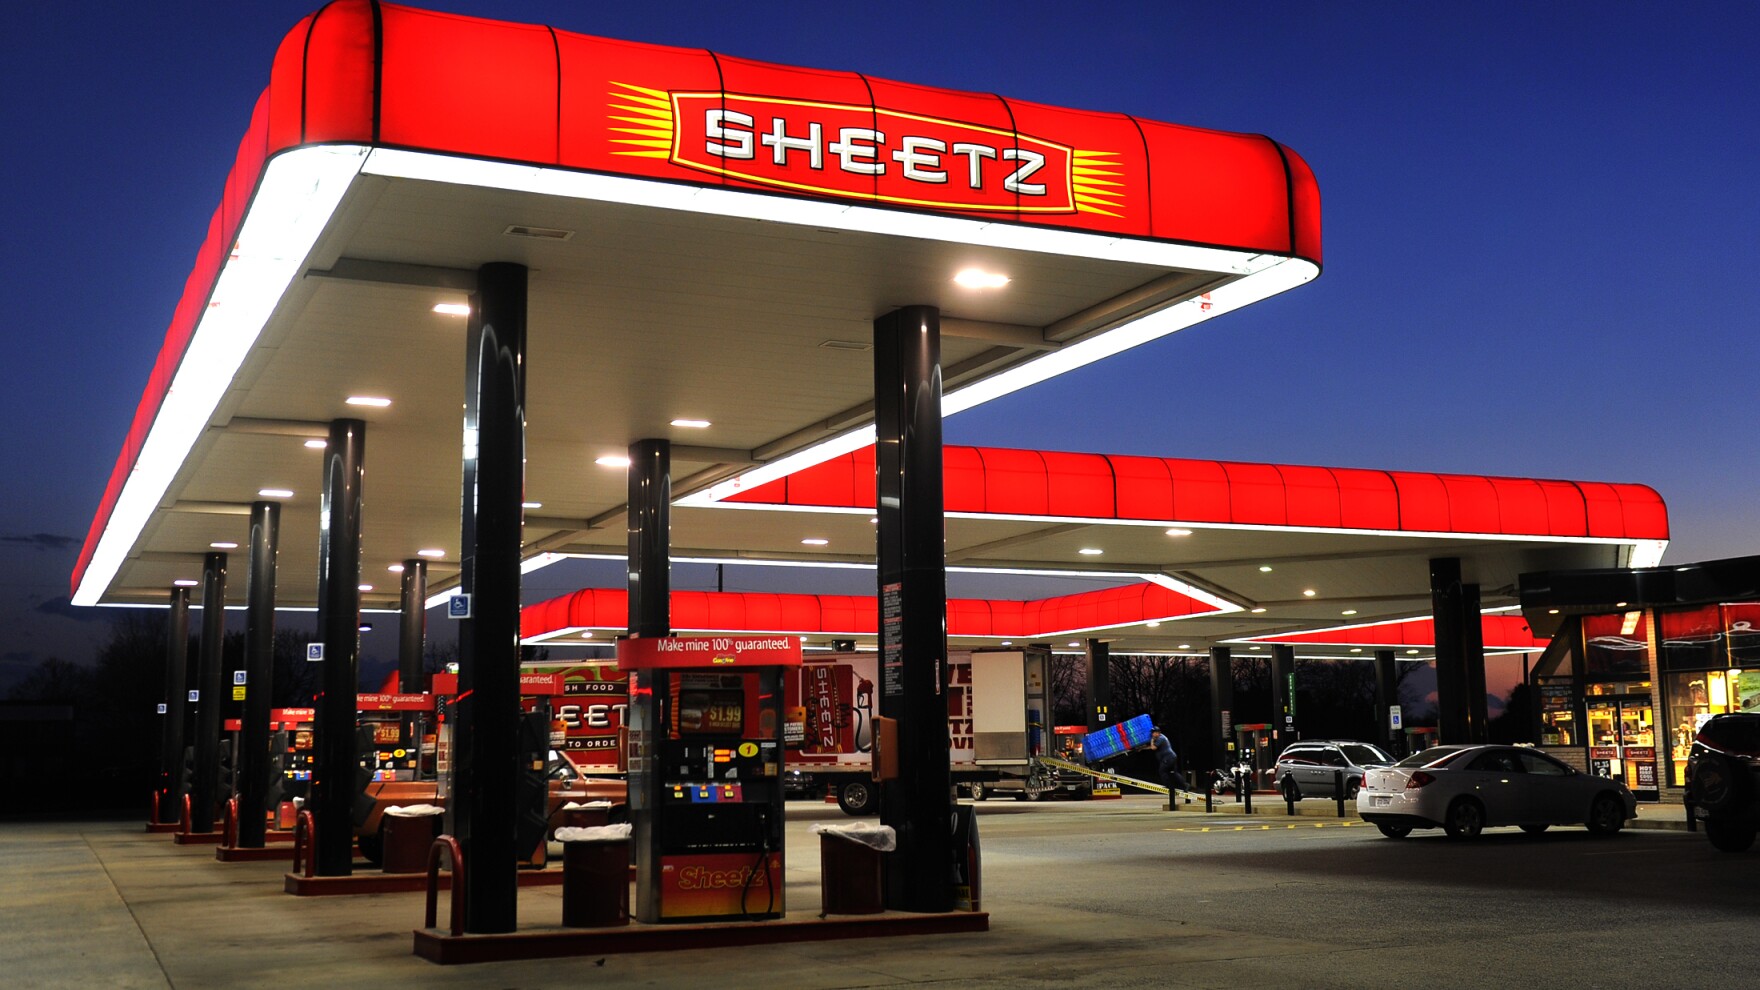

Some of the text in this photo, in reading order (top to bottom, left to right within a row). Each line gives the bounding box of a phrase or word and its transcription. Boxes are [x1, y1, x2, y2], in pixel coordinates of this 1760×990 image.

[705, 108, 1048, 196] SHEETZ
[657, 638, 684, 652] Make
[685, 639, 709, 652] mine
[735, 637, 791, 654] guaranteed.
[392, 694, 425, 704] guaranteed.
[816, 667, 834, 748] SHEETZ
[709, 705, 742, 722] $1.99
[380, 728, 400, 739] $1.99
[567, 740, 581, 748] TO
[745, 744, 752, 755] 1
[678, 865, 765, 890] Sheetz
